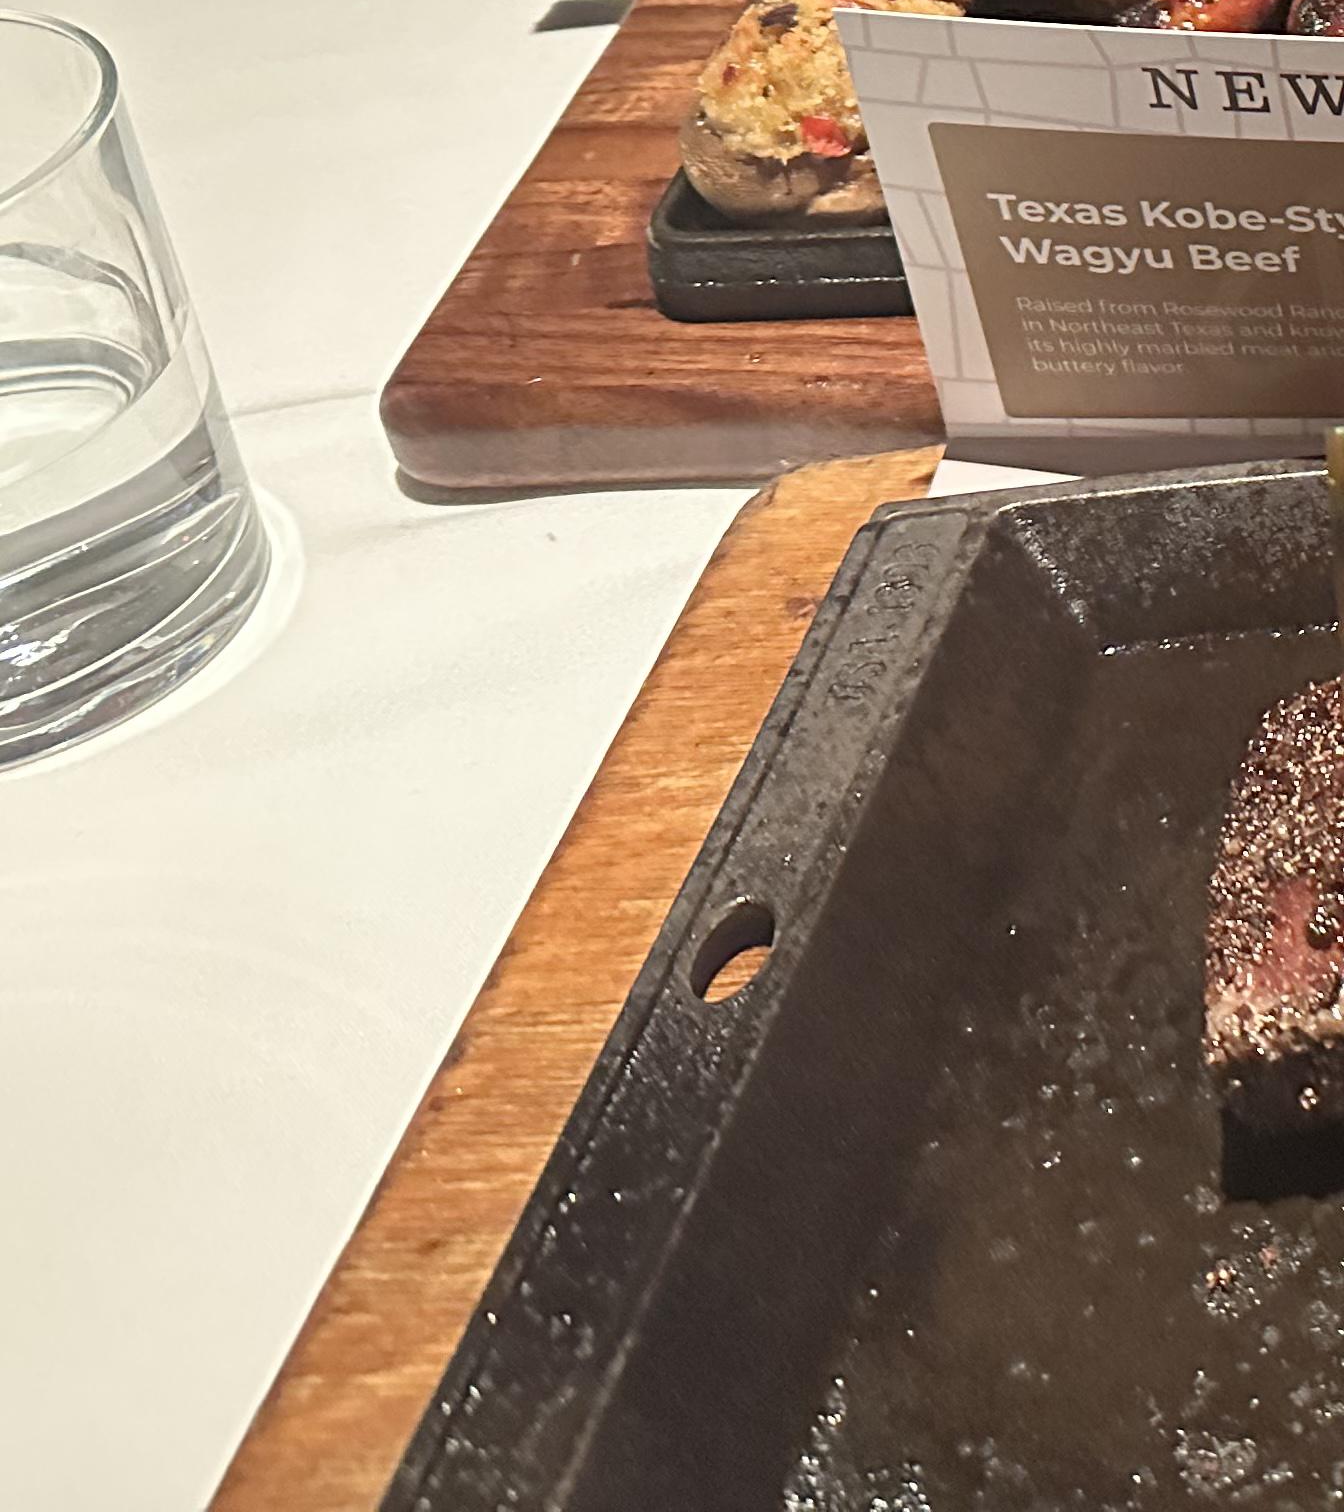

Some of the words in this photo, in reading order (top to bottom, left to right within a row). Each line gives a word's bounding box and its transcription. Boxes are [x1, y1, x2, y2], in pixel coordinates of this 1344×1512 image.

[986, 193, 1128, 227] Texas
[1000, 236, 1174, 275] Wagyu
[1188, 243, 1301, 273] Beef
[1016, 296, 1093, 315] Raised
[1098, 298, 1157, 316] from
[1162, 302, 1283, 320] Rosewood
[1022, 317, 1043, 333] in
[1048, 318, 1165, 337] Northeast
[1171, 321, 1233, 338] Texas
[1240, 323, 1284, 339] and
[1027, 338, 1055, 354] its
[1059, 339, 1130, 358] highly
[1137, 341, 1235, 358] marbled
[1032, 359, 1116, 378] buttery
